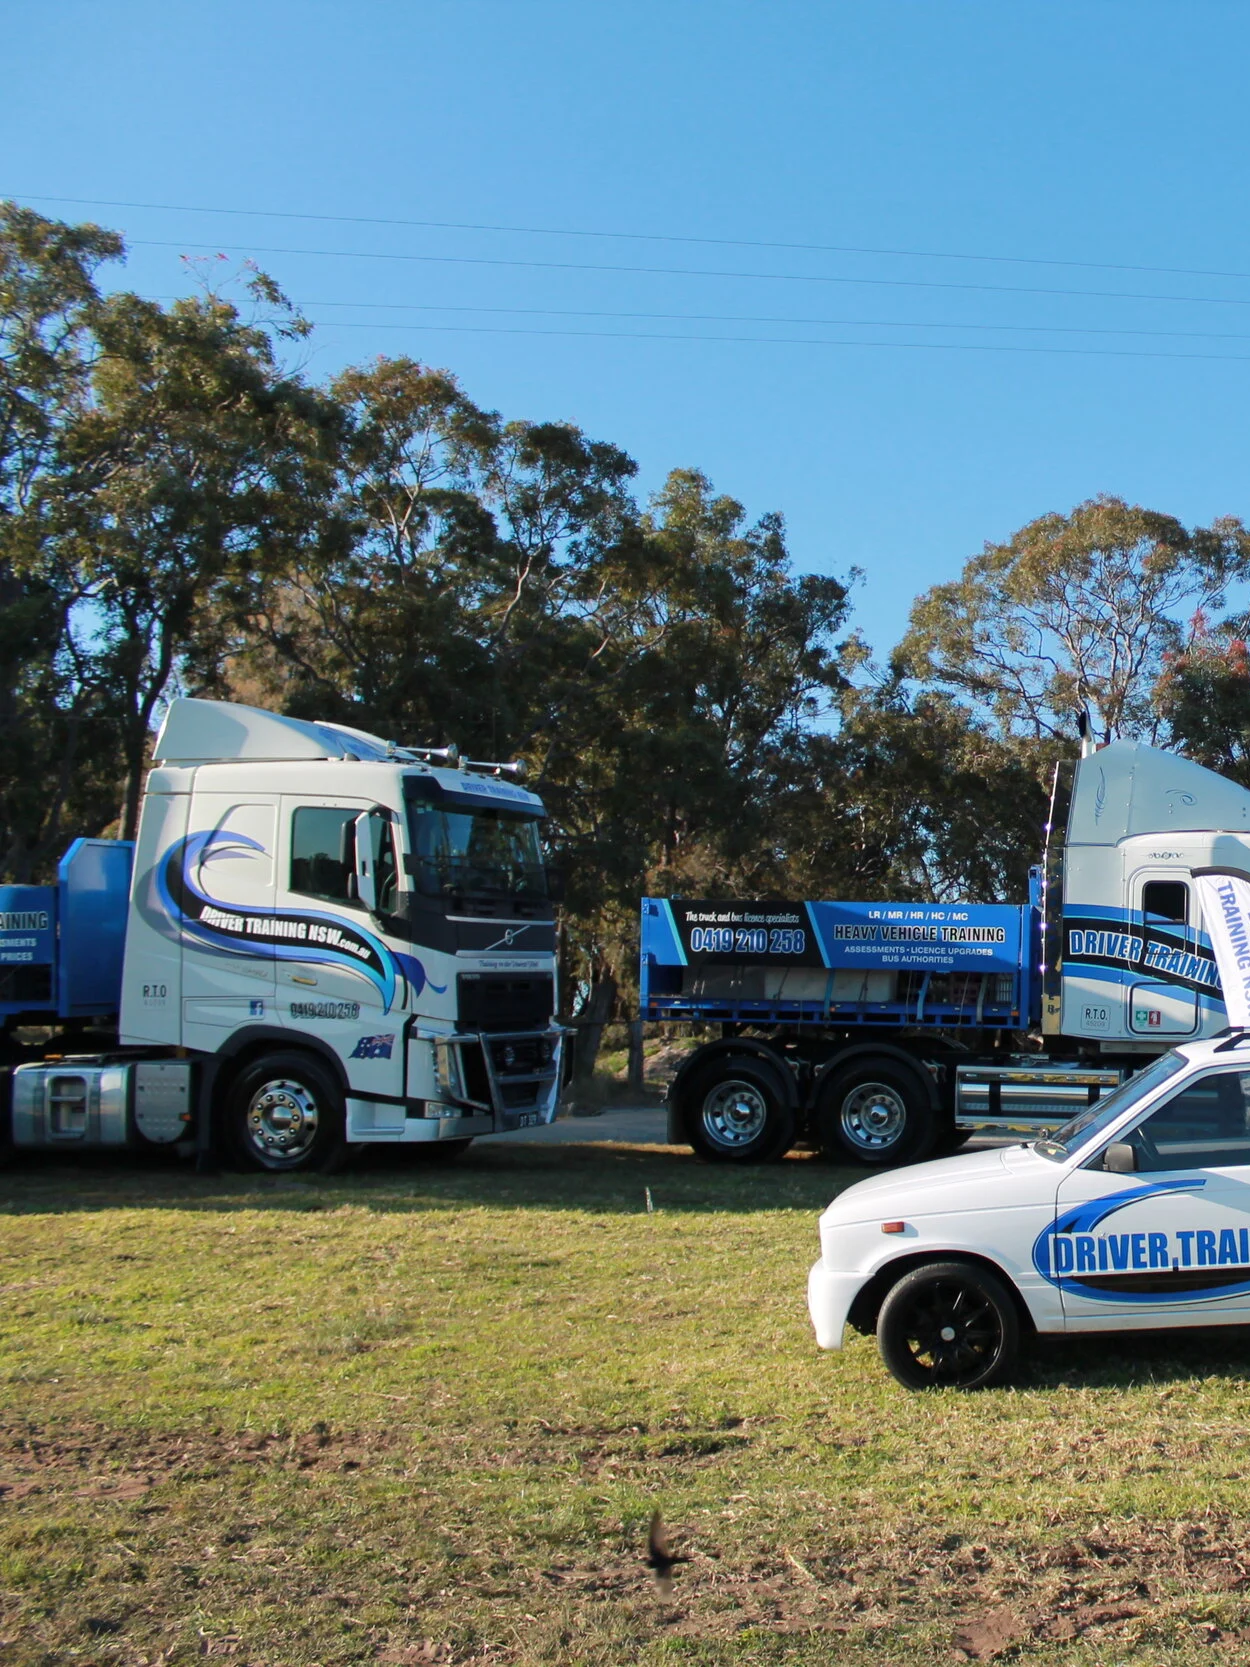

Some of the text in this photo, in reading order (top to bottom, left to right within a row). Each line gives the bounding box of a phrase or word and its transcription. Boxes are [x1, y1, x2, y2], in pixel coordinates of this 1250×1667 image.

[200, 905, 244, 932] DRIVER
[245, 917, 306, 939] TRAINING
[685, 911, 697, 922] The
[699, 912, 717, 922] truck
[717, 912, 730, 922] and
[731, 912, 743, 922] bus
[868, 911, 881, 919] LR
[888, 911, 903, 920] MR
[910, 911, 924, 920] HR
[931, 912, 945, 920] HC
[952, 912, 968, 921] MC
[691, 927, 805, 954] 0419 210 258
[834, 925, 1006, 942] HEAVY VEHICLE TRAINING
[845, 946, 905, 954] ASSESSMENTS
[948, 947, 993, 956] UPGRADES
[1069, 930, 1144, 962] DRIVER
[882, 955, 954, 964] BUS AUTHORITIES
[1085, 1008, 1108, 1020] R.T.O.
[1053, 1232, 1168, 1273] DRIVER
